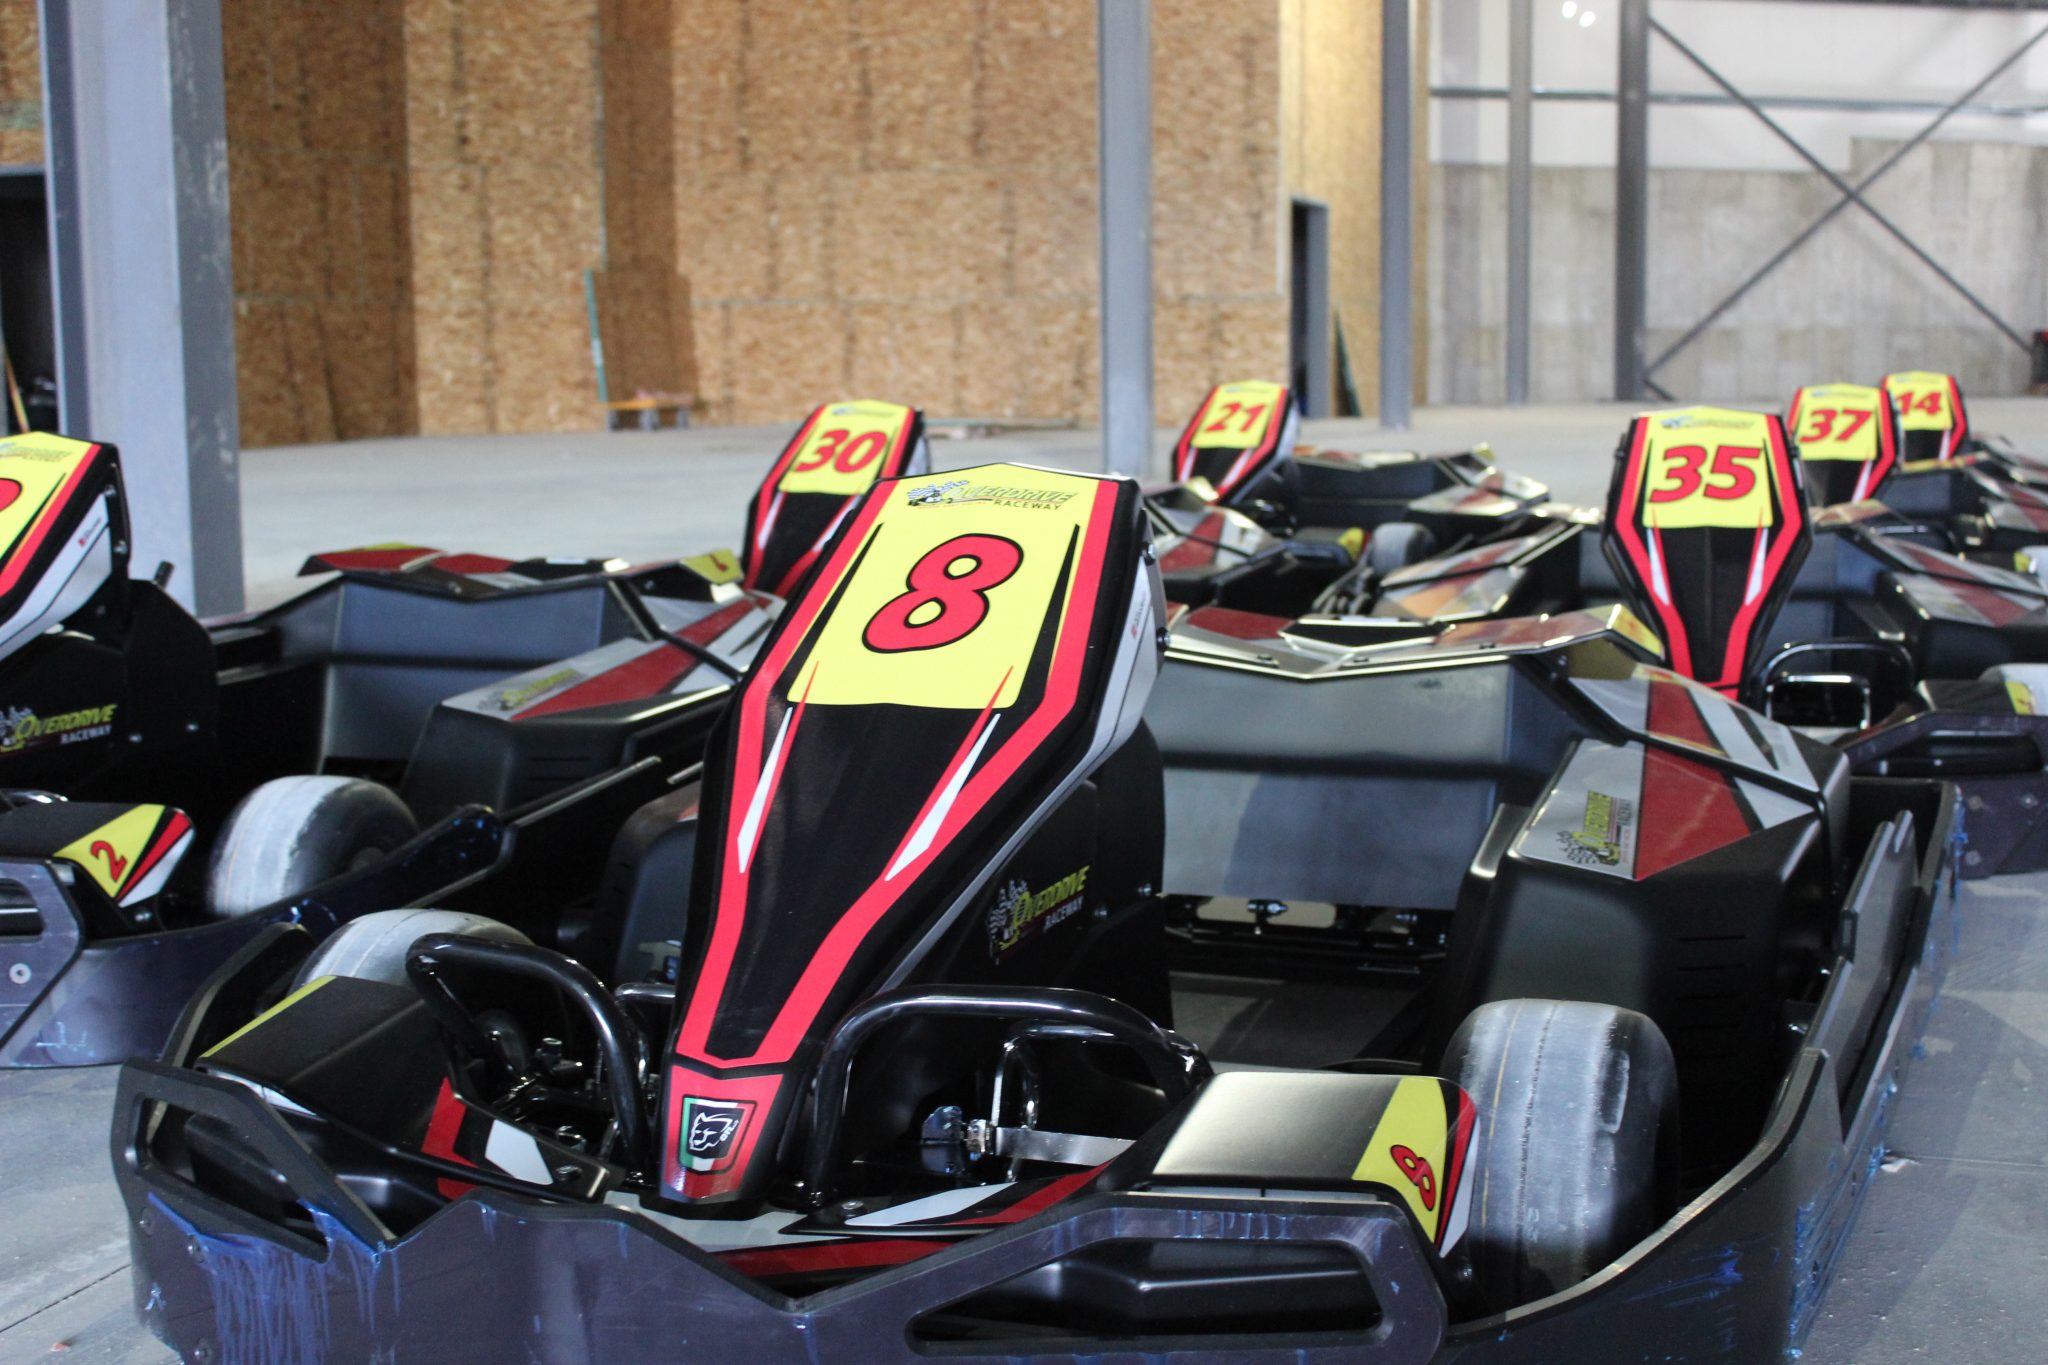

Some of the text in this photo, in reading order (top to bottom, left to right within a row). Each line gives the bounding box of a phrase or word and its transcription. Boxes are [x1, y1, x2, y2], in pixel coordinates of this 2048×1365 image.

[1204, 402, 1266, 433] 21
[1895, 391, 1942, 416] 14
[1799, 408, 1873, 443] 37
[794, 428, 889, 474] 30
[1648, 444, 1762, 503] 35
[993, 499, 1062, 511] RACEWAY
[862, 533, 1024, 654] 8
[60, 723, 113, 745] RACEWAY
[89, 839, 128, 883] 2
[1043, 895, 1084, 932] RACEWAY
[1389, 1144, 1437, 1211] 8
